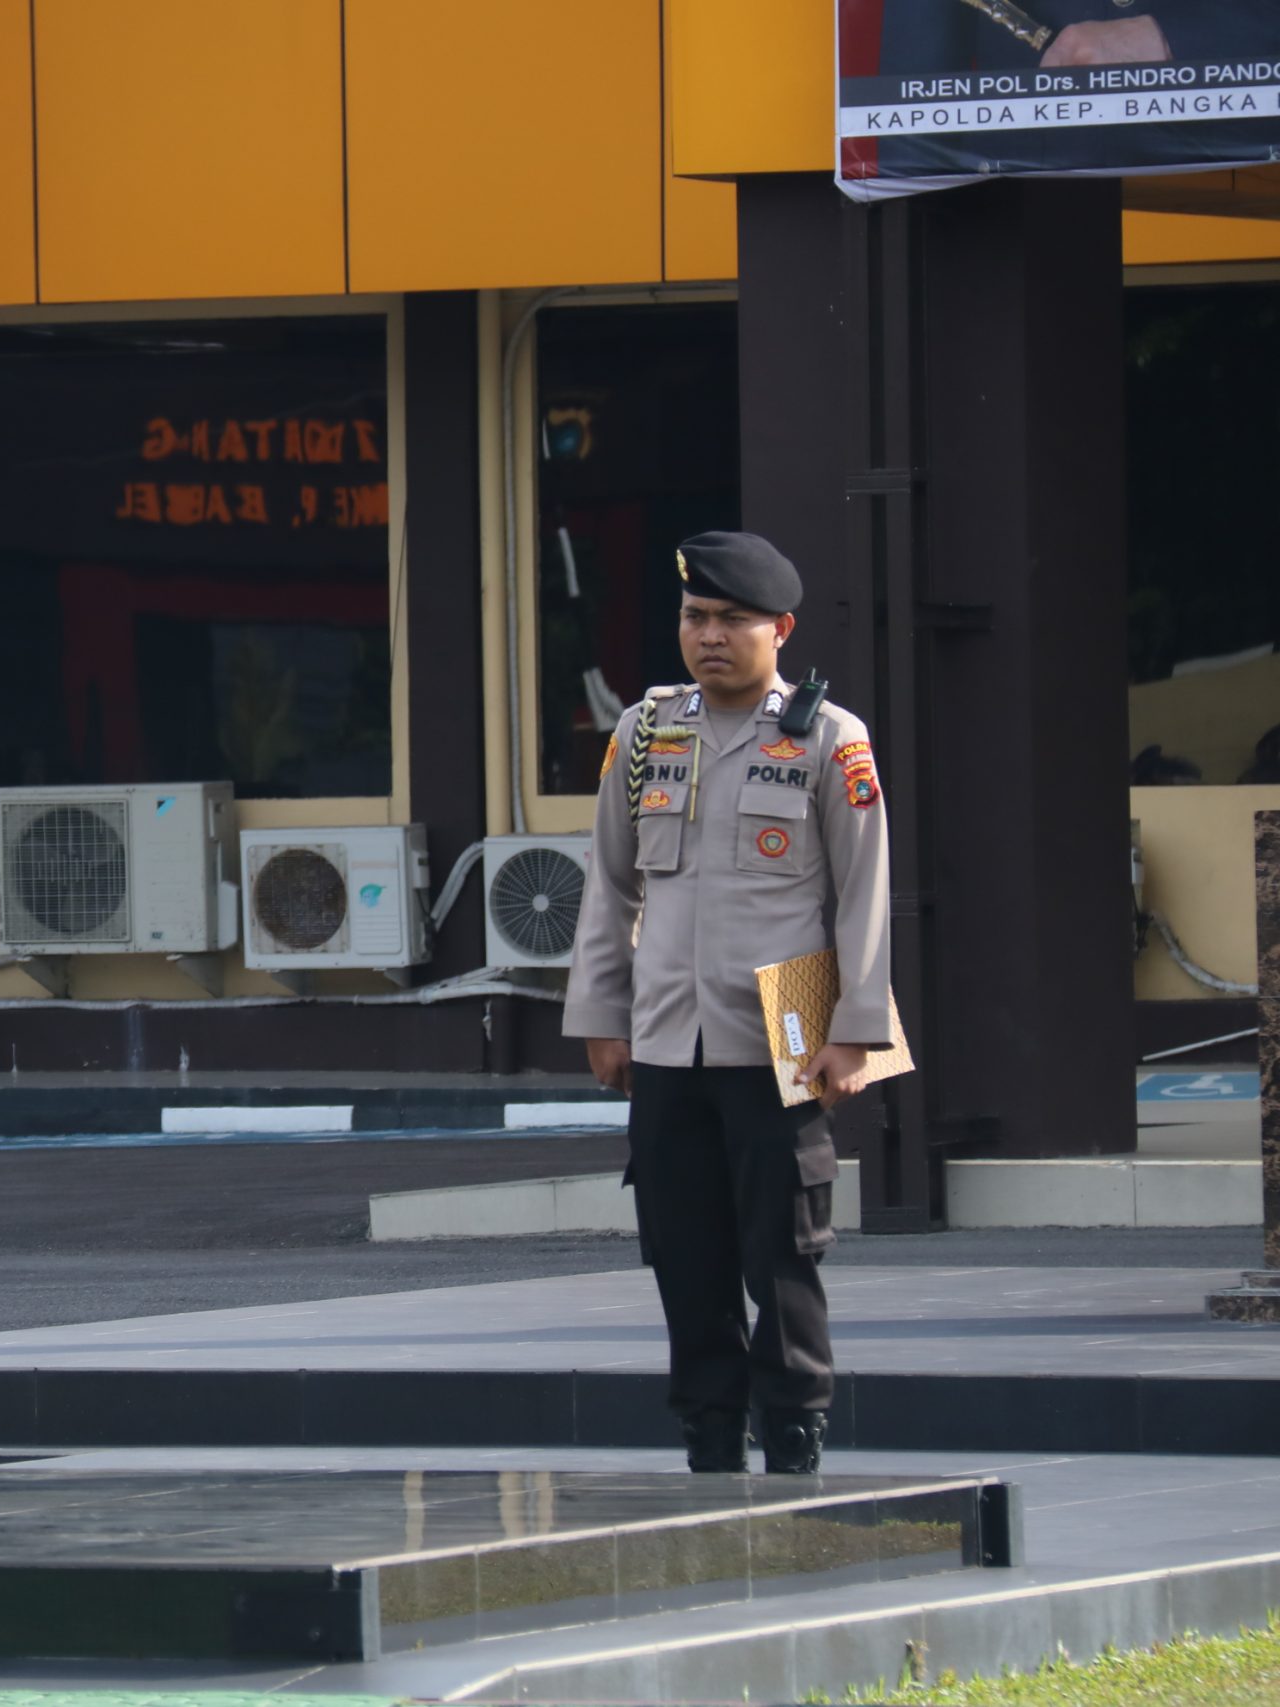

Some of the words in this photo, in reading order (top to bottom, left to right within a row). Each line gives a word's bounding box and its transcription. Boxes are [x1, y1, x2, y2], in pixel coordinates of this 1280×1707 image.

[901, 78, 971, 99] IRJEN
[979, 75, 1028, 95] POL
[1035, 73, 1081, 92] Drs.
[1089, 67, 1197, 89] HENDRO
[867, 105, 1015, 129] KAPOLDA
[1034, 102, 1104, 121] KEP.
[1125, 93, 1257, 117] BANGKA
[837, 743, 869, 761] POLDA
[747, 765, 809, 787] POLRI
